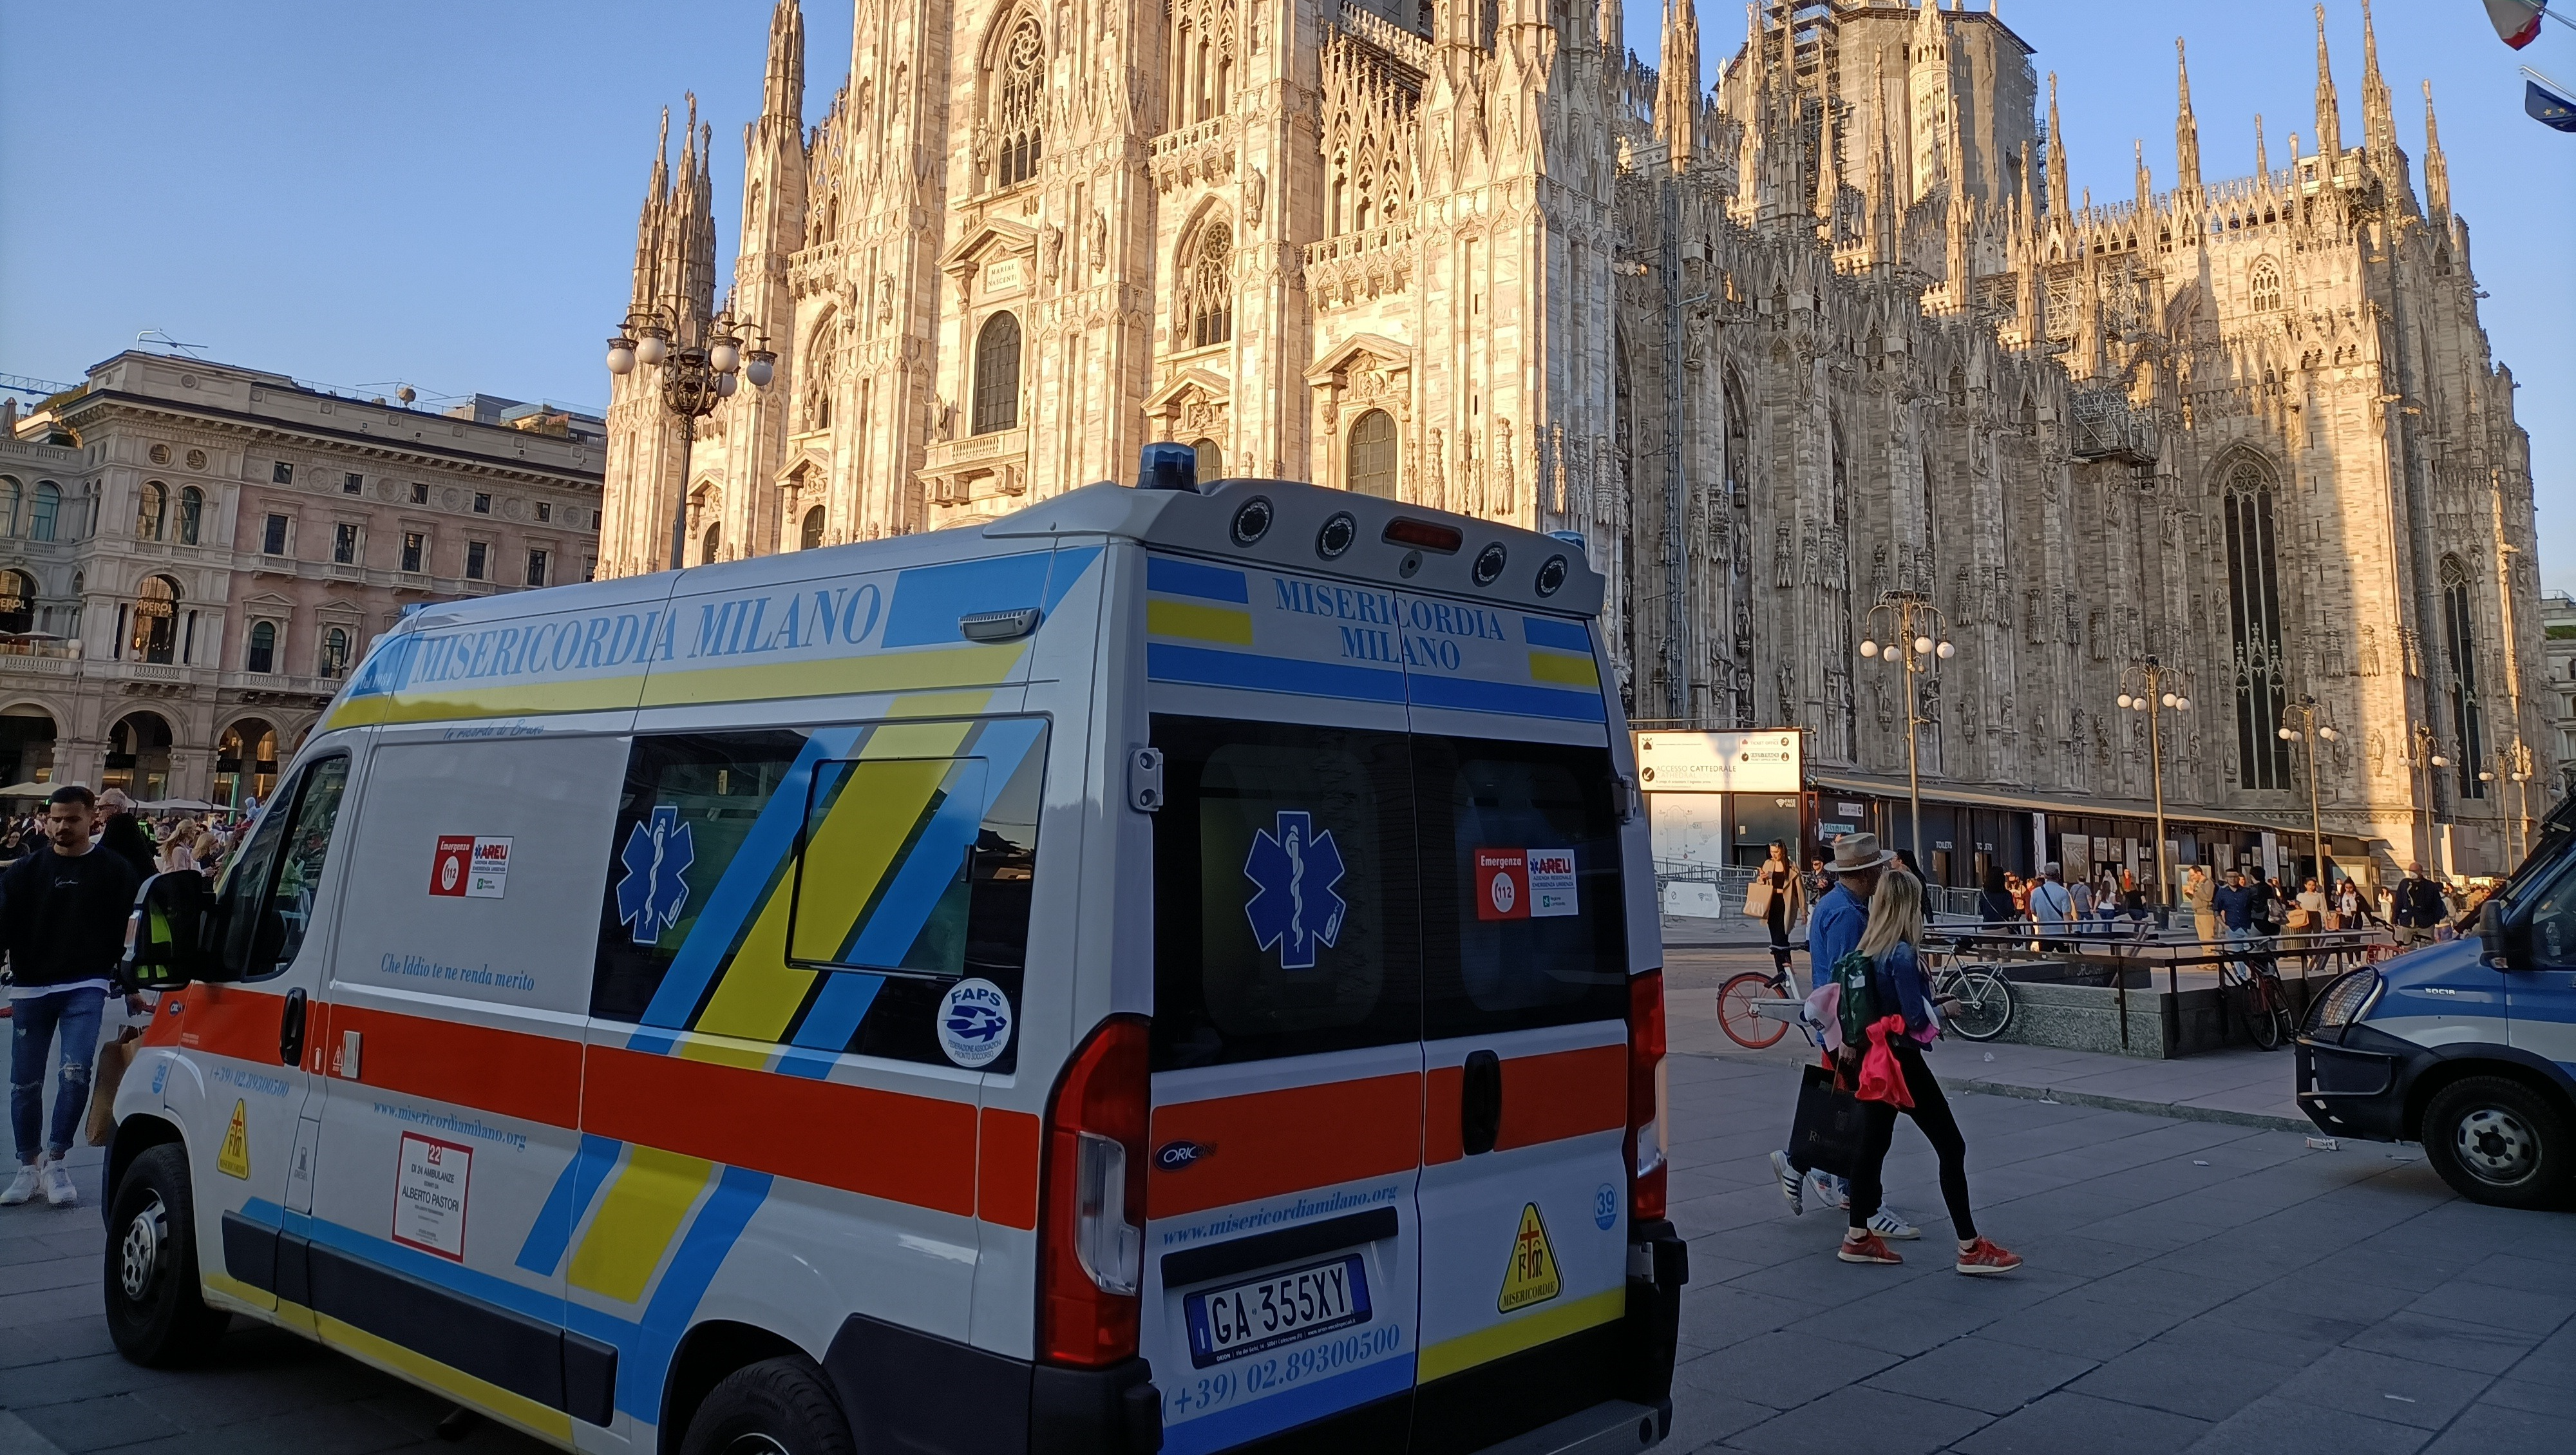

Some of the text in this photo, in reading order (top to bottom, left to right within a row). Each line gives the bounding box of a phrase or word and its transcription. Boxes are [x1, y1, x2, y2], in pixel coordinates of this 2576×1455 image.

[991, 263, 1014, 276] MARIAE
[988, 274, 1017, 287] NASCENTI
[0, 598, 26, 613] EROL
[135, 597, 173, 614] APEROL
[1273, 578, 1506, 642] MISERICORDIA
[412, 583, 882, 684] MISERICORDIA MILANO
[1338, 625, 1461, 671] MILANO
[440, 841, 470, 853] Emergenza
[480, 844, 509, 860] AREU
[1935, 841, 1953, 849] TOILETS
[1481, 855, 1522, 869] Emergenza
[1539, 858, 1571, 874] AREU
[446, 868, 457, 879] 112
[1498, 886, 1512, 899] 112
[381, 953, 535, 992] Che Iddio te ne renda merito
[951, 988, 1001, 1006] FAPS
[947, 1039, 1001, 1052] FEDERAZIONE ASSOCIAZIONI
[954, 1050, 994, 1060] PRONTO SOCCORSO
[155, 1064, 167, 1083] 39
[210, 1065, 290, 1098] (+39) 02.89300500
[374, 1101, 527, 1153] www.misericordiamilano.org
[428, 1145, 441, 1162] 22
[294, 1169, 308, 1182] DIESEL
[411, 1164, 455, 1184] DI 24 AMBULANZE
[401, 1185, 431, 1204] ALBERTO
[431, 1193, 459, 1212] PASTORI
[1597, 1190, 1615, 1215] 39
[1163, 1185, 1395, 1246] www.misericordiamilano.org
[1502, 1281, 1555, 1307] MISERICORDIE
[1212, 1291, 1251, 1345] GA
[1258, 1267, 1345, 1332] 355XY
[1216, 1353, 1231, 1362] ORION
[1162, 1324, 1400, 1424] (+39) 02.89300500
